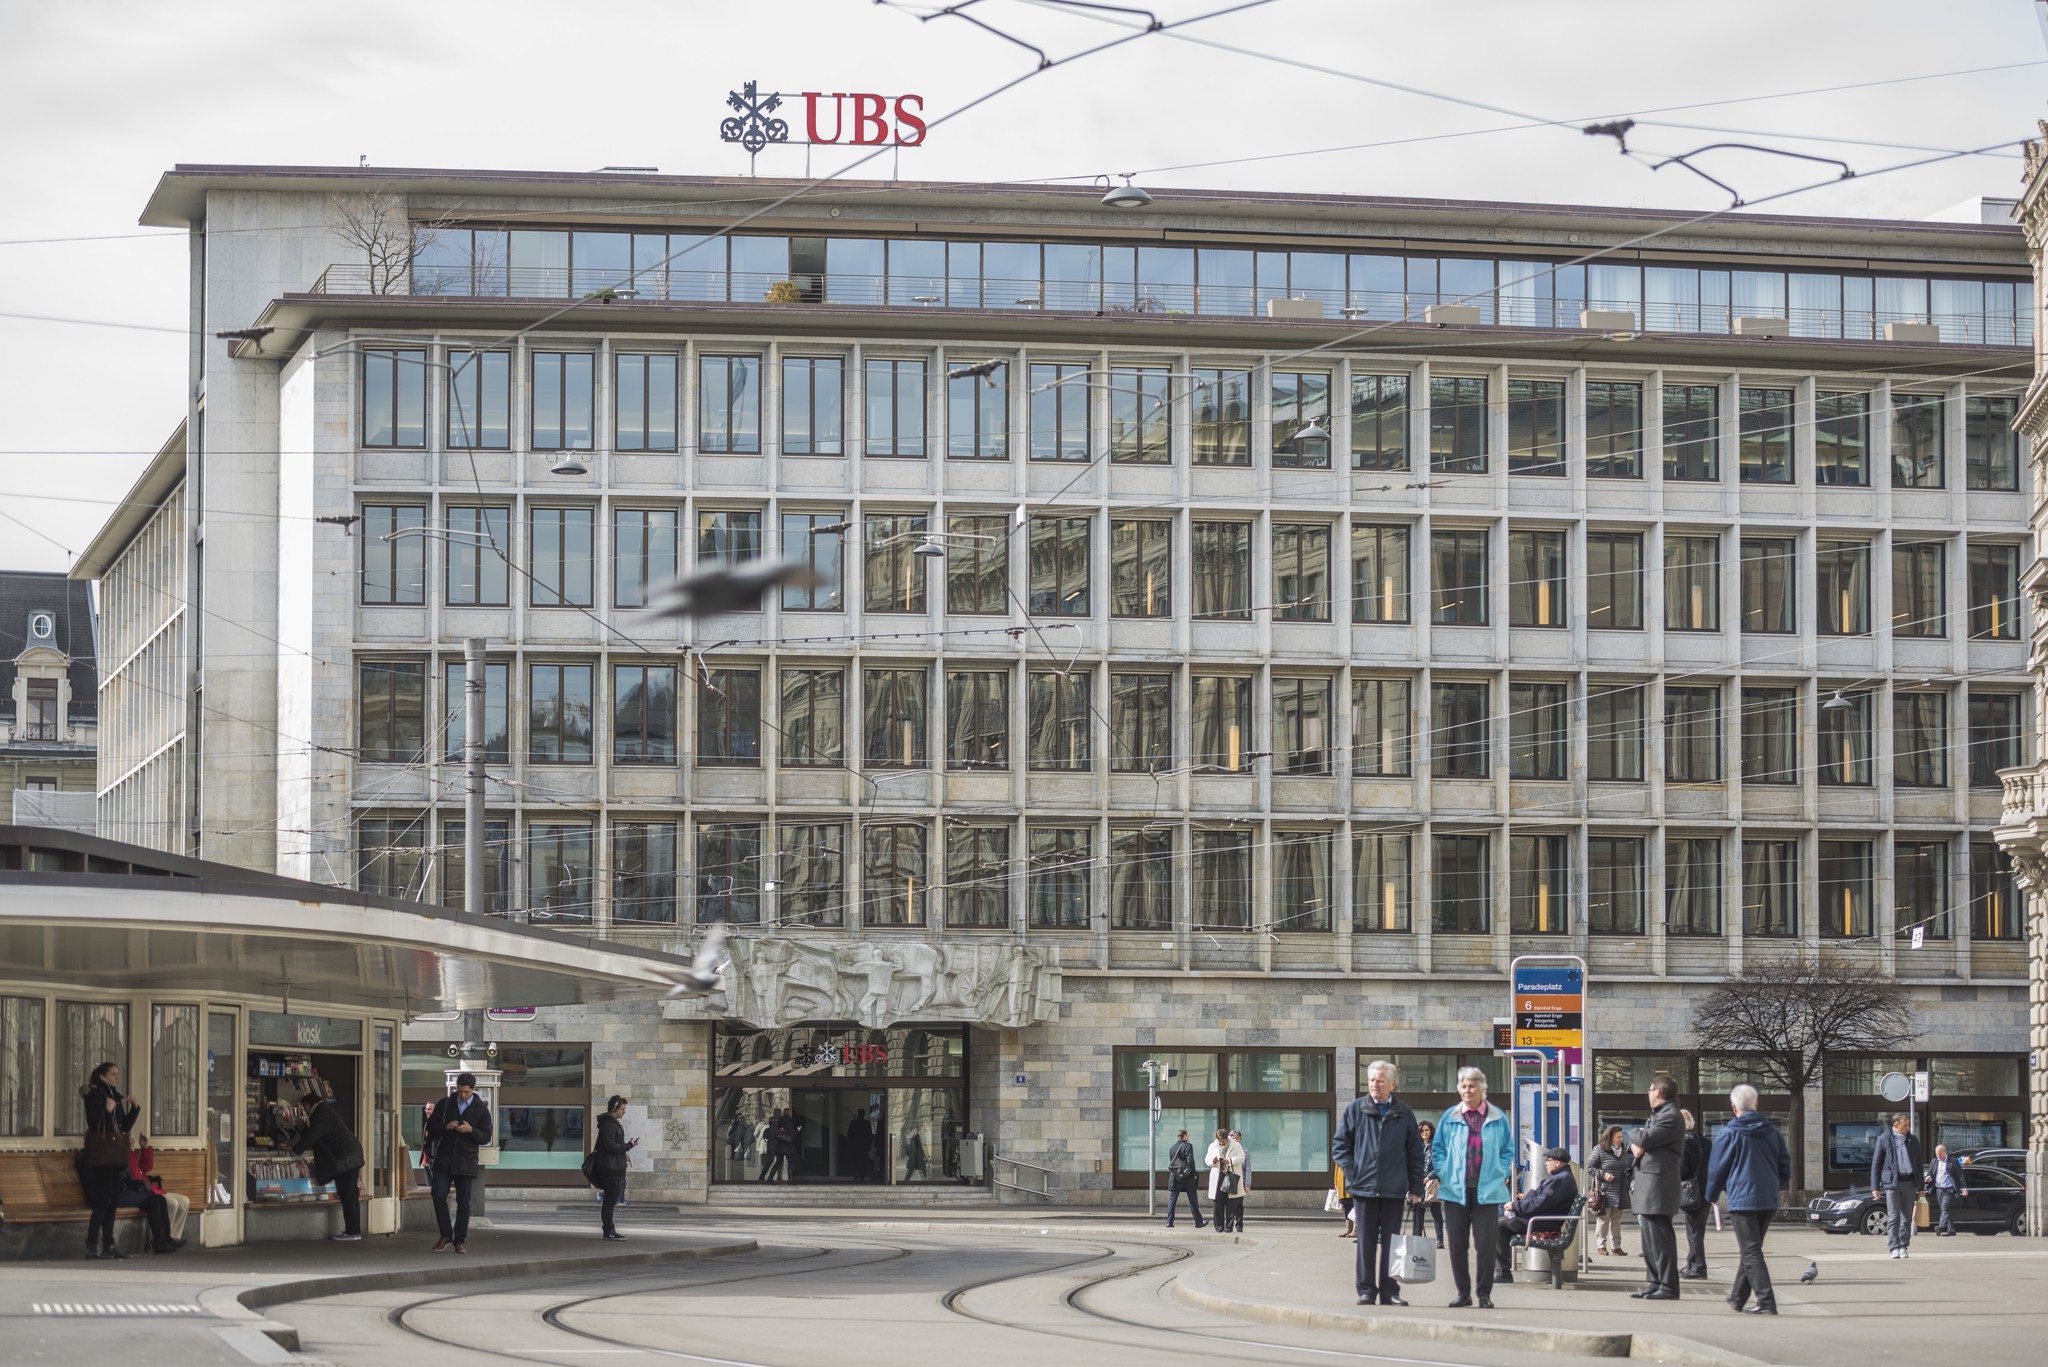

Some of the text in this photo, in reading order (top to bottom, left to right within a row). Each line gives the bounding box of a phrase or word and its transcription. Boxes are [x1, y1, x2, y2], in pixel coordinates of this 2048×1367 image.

[801, 91, 927, 147] UBS
[1518, 983, 1563, 991] Paradeplatz
[1525, 1001, 1532, 1010] 6
[1525, 1018, 1532, 1028] 7
[1521, 1036, 1532, 1046] 13
[843, 1043, 887, 1064] UBS
